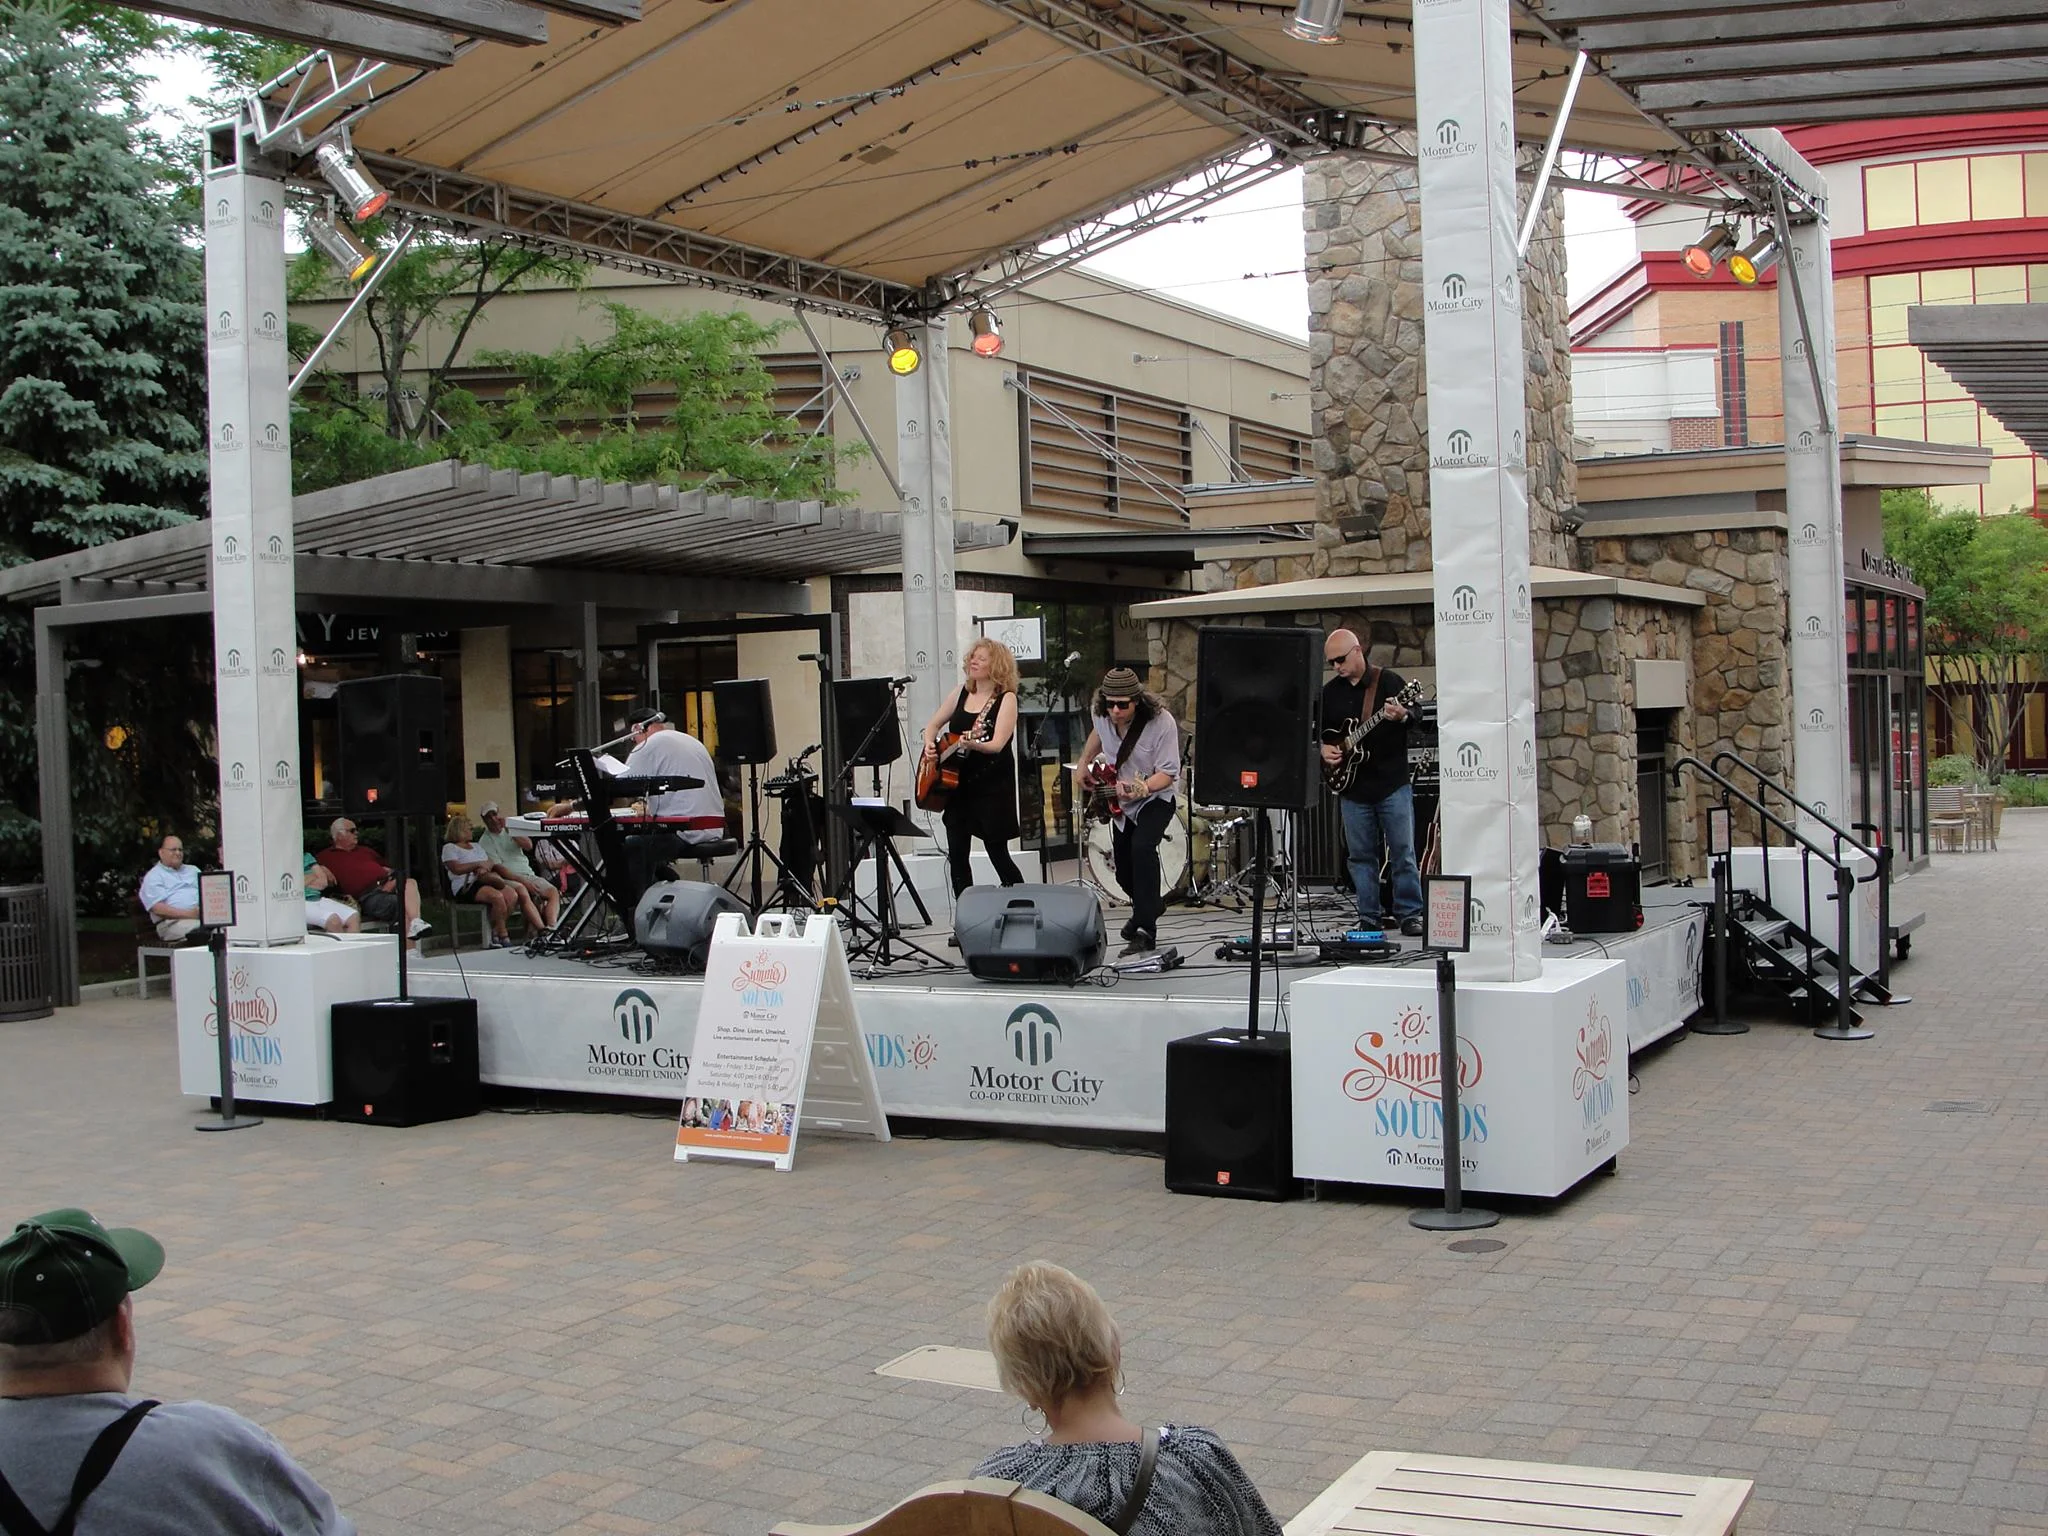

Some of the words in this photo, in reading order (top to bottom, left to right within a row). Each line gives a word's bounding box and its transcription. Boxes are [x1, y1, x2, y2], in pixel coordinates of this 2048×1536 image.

[1421, 146, 1454, 158] Motor
[1455, 142, 1477, 154] City
[1427, 300, 1459, 311] Motor
[1461, 297, 1483, 309] City
[1432, 456, 1464, 467] Motor
[1467, 453, 1489, 465] City
[1438, 612, 1470, 622] Motor
[1472, 610, 1495, 622] City
[1009, 645, 1032, 654] DIVA
[1443, 767, 1474, 778] Motor
[1476, 767, 1499, 779] City
[1431, 902, 1462, 911] PLEASE
[1432, 930, 1459, 938] STAGE
[1480, 923, 1502, 935] City
[732, 960, 786, 991] Summer
[230, 1035, 282, 1065] OUNDS
[717, 1053, 753, 1061] Entertainment
[587, 1044, 646, 1067] Motor
[653, 1047, 691, 1076] City
[702, 1061, 722, 1069] Monday
[1343, 1032, 1482, 1101] Summr
[588, 1066, 616, 1075] CO-OP
[618, 1067, 651, 1078] CREDIT
[653, 1070, 683, 1080] UNION
[239, 1074, 261, 1083] Motor
[263, 1075, 278, 1087] City
[969, 1065, 1044, 1091] Motor
[1051, 1069, 1104, 1101] City
[969, 1090, 1005, 1100] CO-OP
[1007, 1092, 1048, 1104] CREDIT
[1051, 1095, 1090, 1106] UNION
[1405, 1152, 1443, 1166] Motor
[1461, 1156, 1478, 1172] ity
